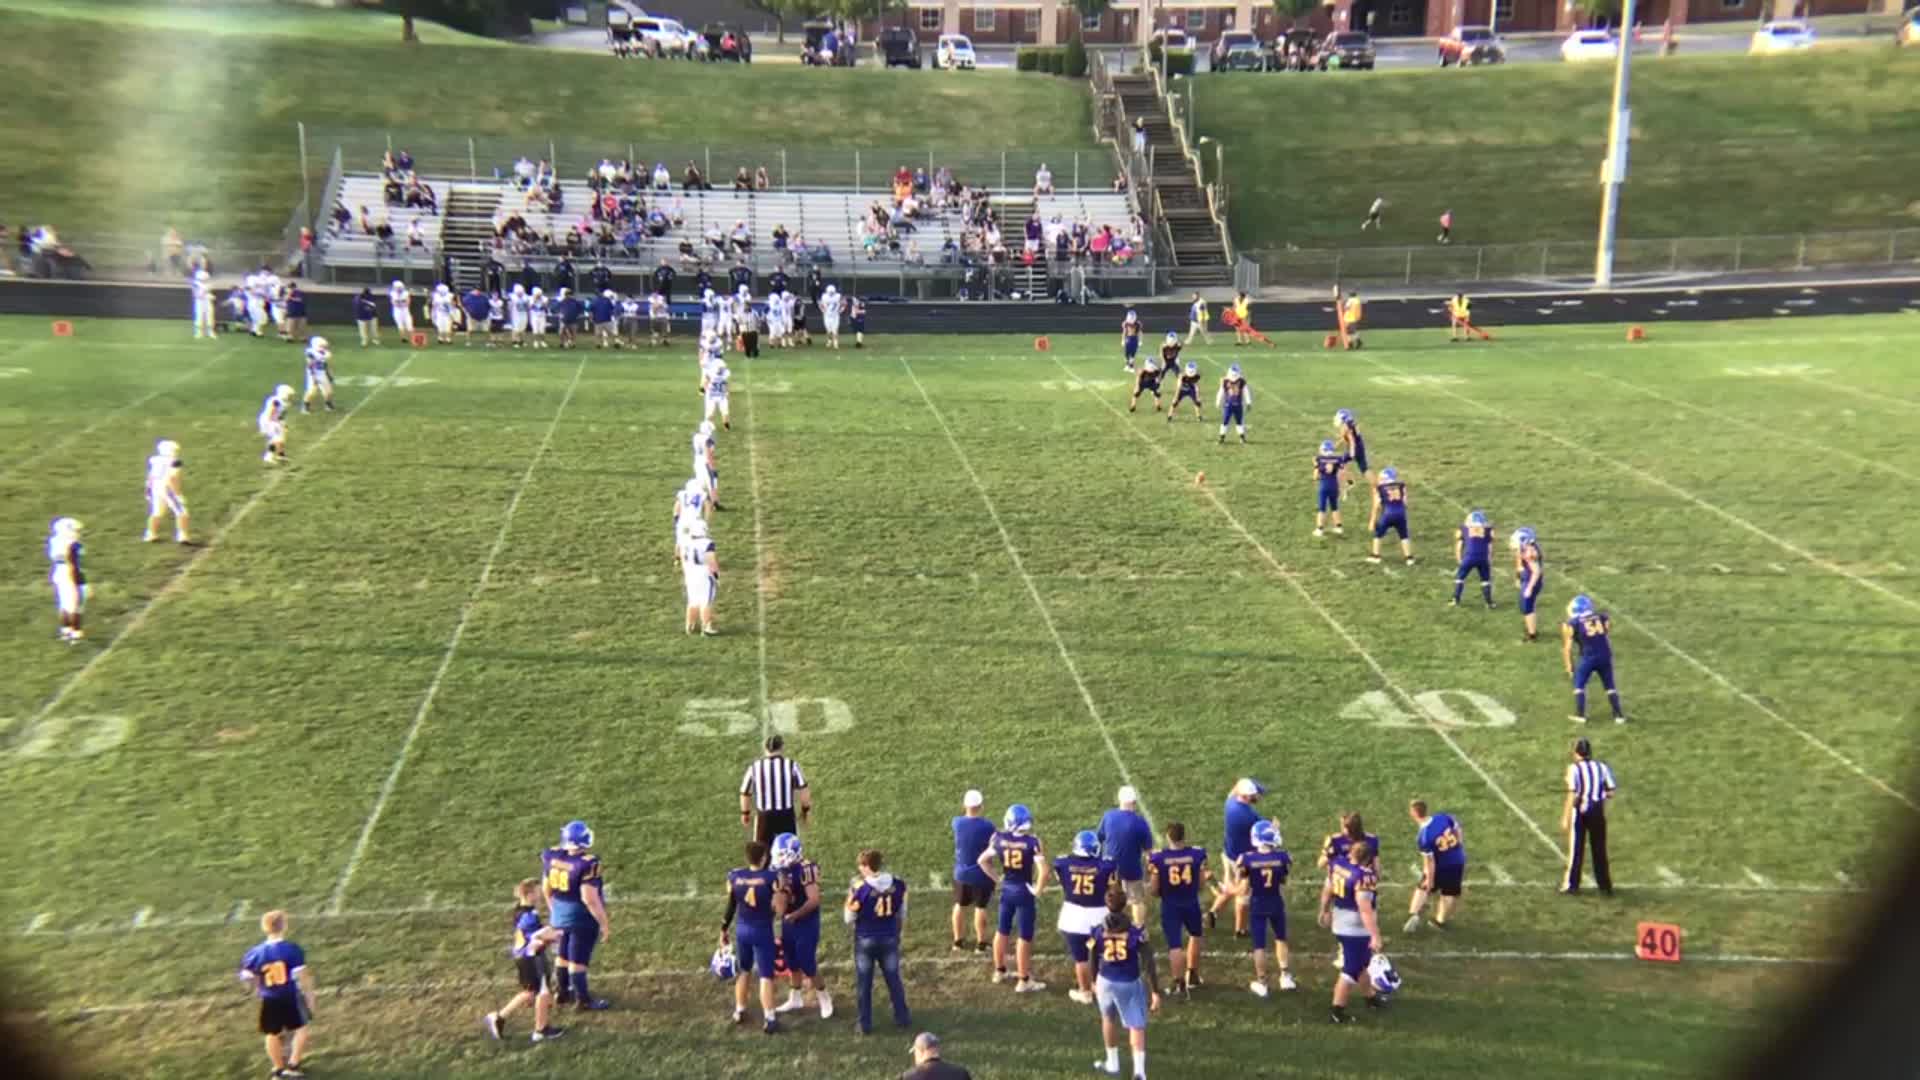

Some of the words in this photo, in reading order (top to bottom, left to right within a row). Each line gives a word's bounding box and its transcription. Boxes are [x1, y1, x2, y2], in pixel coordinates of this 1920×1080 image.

[1583, 617, 1605, 637] 54
[679, 697, 854, 737] 50
[1339, 689, 1518, 728] 40
[1003, 848, 1024, 870] 12
[1071, 874, 1095, 896] 75
[1168, 864, 1192, 886] 64
[1260, 868, 1274, 888] 7
[744, 887, 757, 907] 4
[874, 895, 892, 917] 41
[1103, 938, 1127, 961] 25
[1641, 927, 1677, 957] 40
